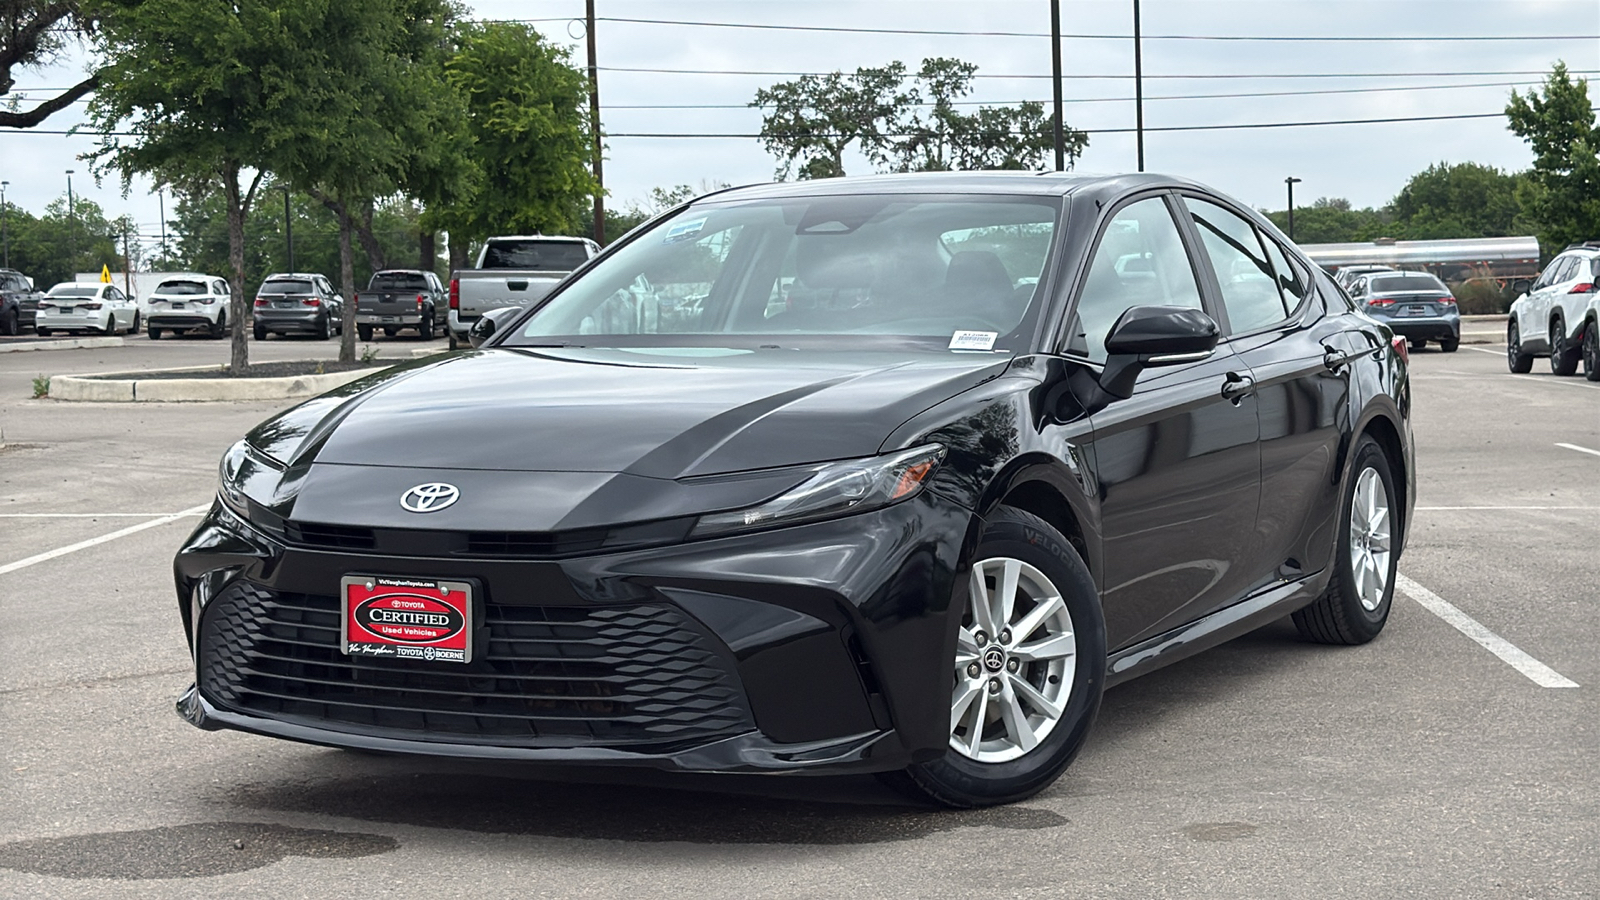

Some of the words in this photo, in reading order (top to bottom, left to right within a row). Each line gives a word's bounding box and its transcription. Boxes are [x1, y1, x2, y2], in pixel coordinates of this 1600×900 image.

[378, 579, 435, 588] VicVaughanToyota.com
[401, 601, 425, 609] TOYOTA
[369, 608, 450, 626] CERTIFIED
[382, 626, 403, 634] Used
[404, 628, 437, 637] Vehicles
[397, 648, 424, 657] TOYOTA
[435, 651, 464, 660] BOERNE
